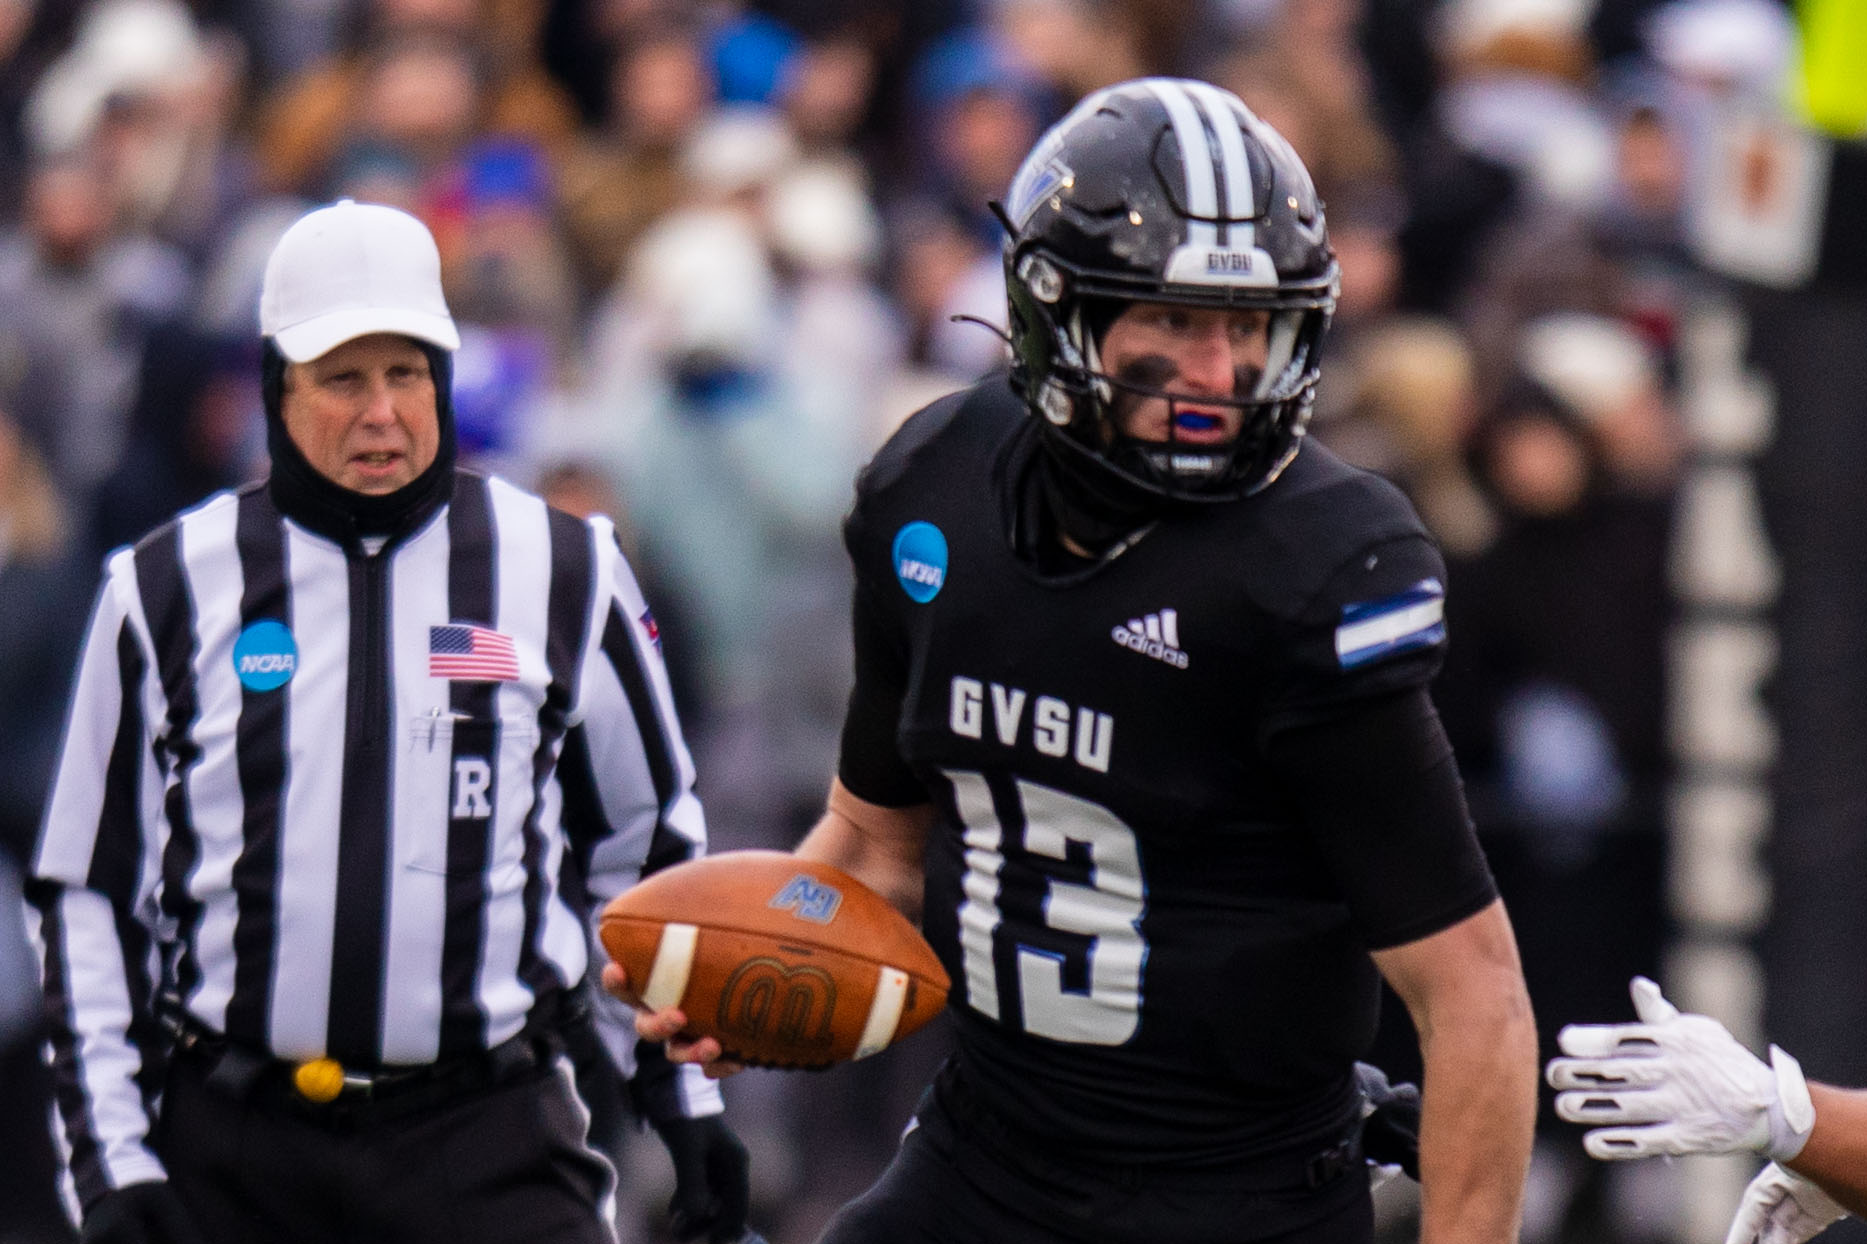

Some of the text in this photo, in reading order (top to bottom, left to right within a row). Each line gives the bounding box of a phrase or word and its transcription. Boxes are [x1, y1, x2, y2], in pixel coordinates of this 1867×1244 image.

[240, 654, 295, 674] NCAA
[1111, 625, 1189, 670] adidas
[950, 674, 1114, 774] GVSU
[452, 760, 493, 820] R
[941, 768, 1150, 1047] 13
